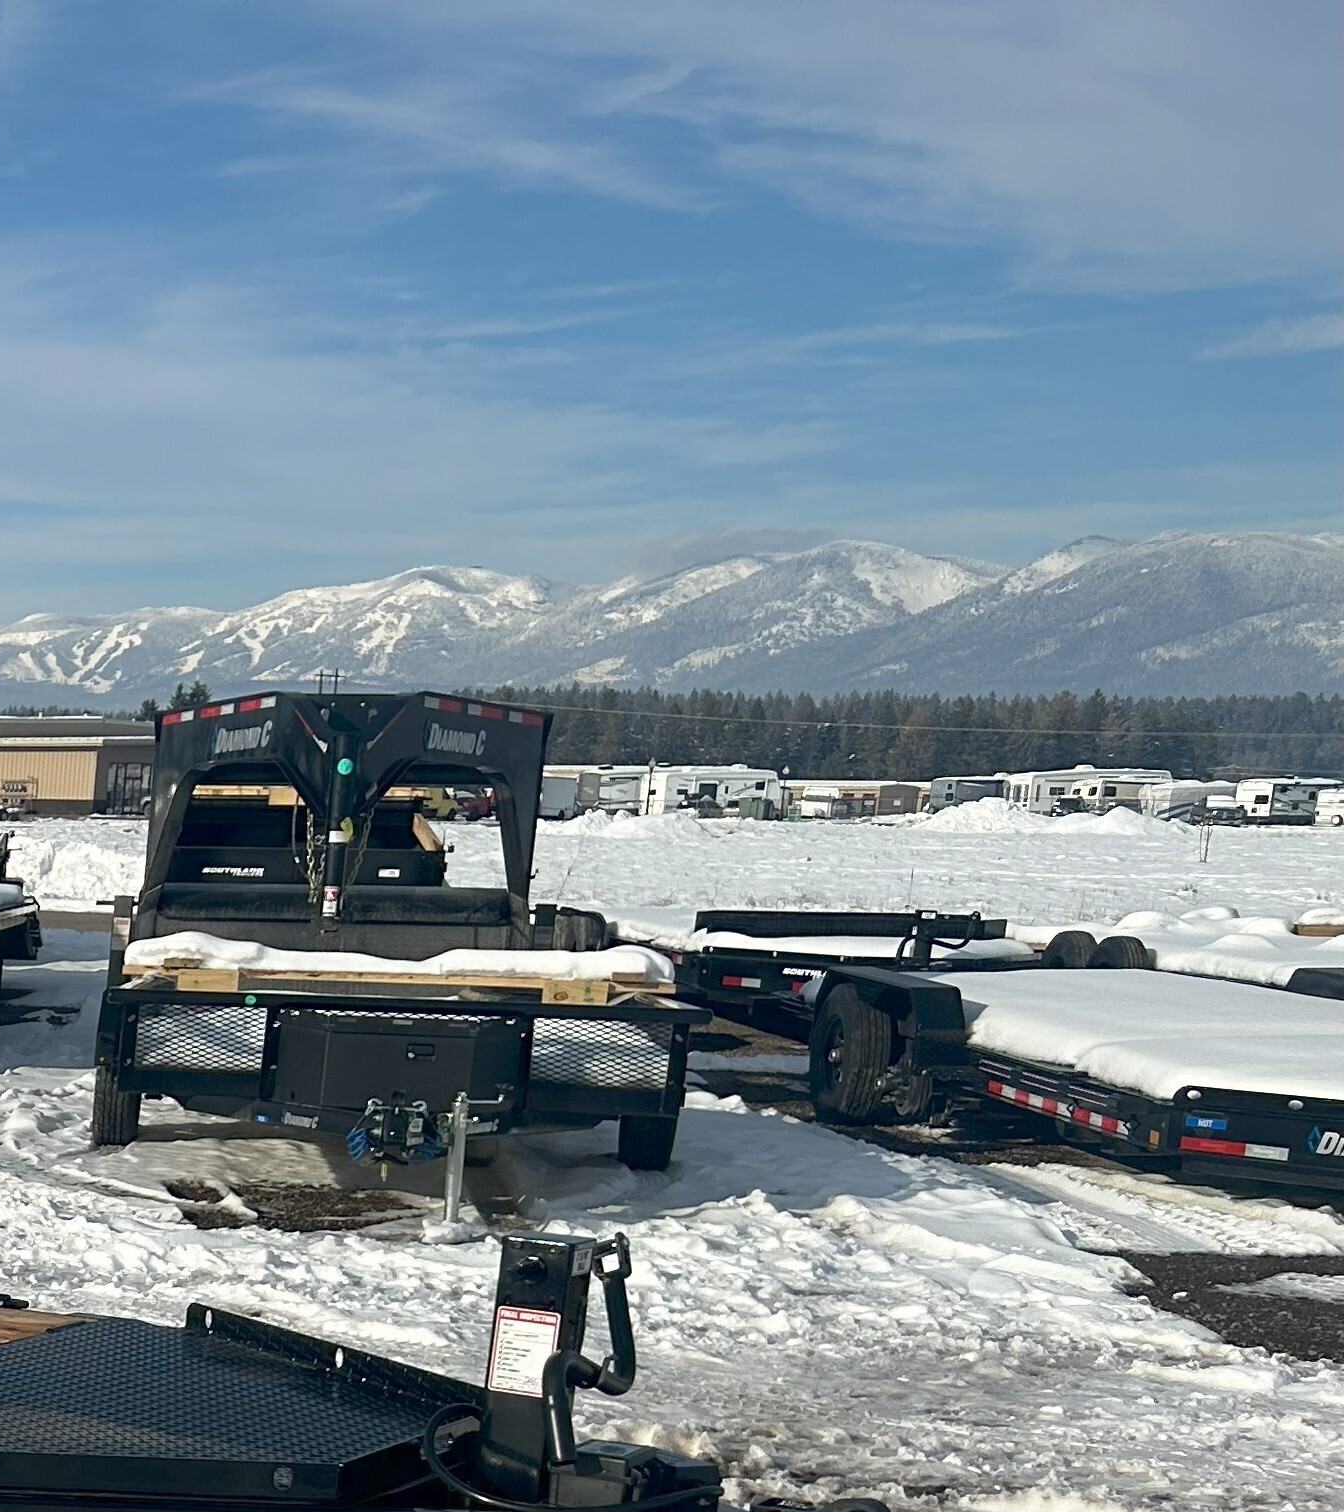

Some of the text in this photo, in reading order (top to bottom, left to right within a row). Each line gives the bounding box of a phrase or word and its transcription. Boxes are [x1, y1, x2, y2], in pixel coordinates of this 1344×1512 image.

[213, 720, 273, 754] DIAMOND C
[427, 722, 487, 756] DIAMOND C
